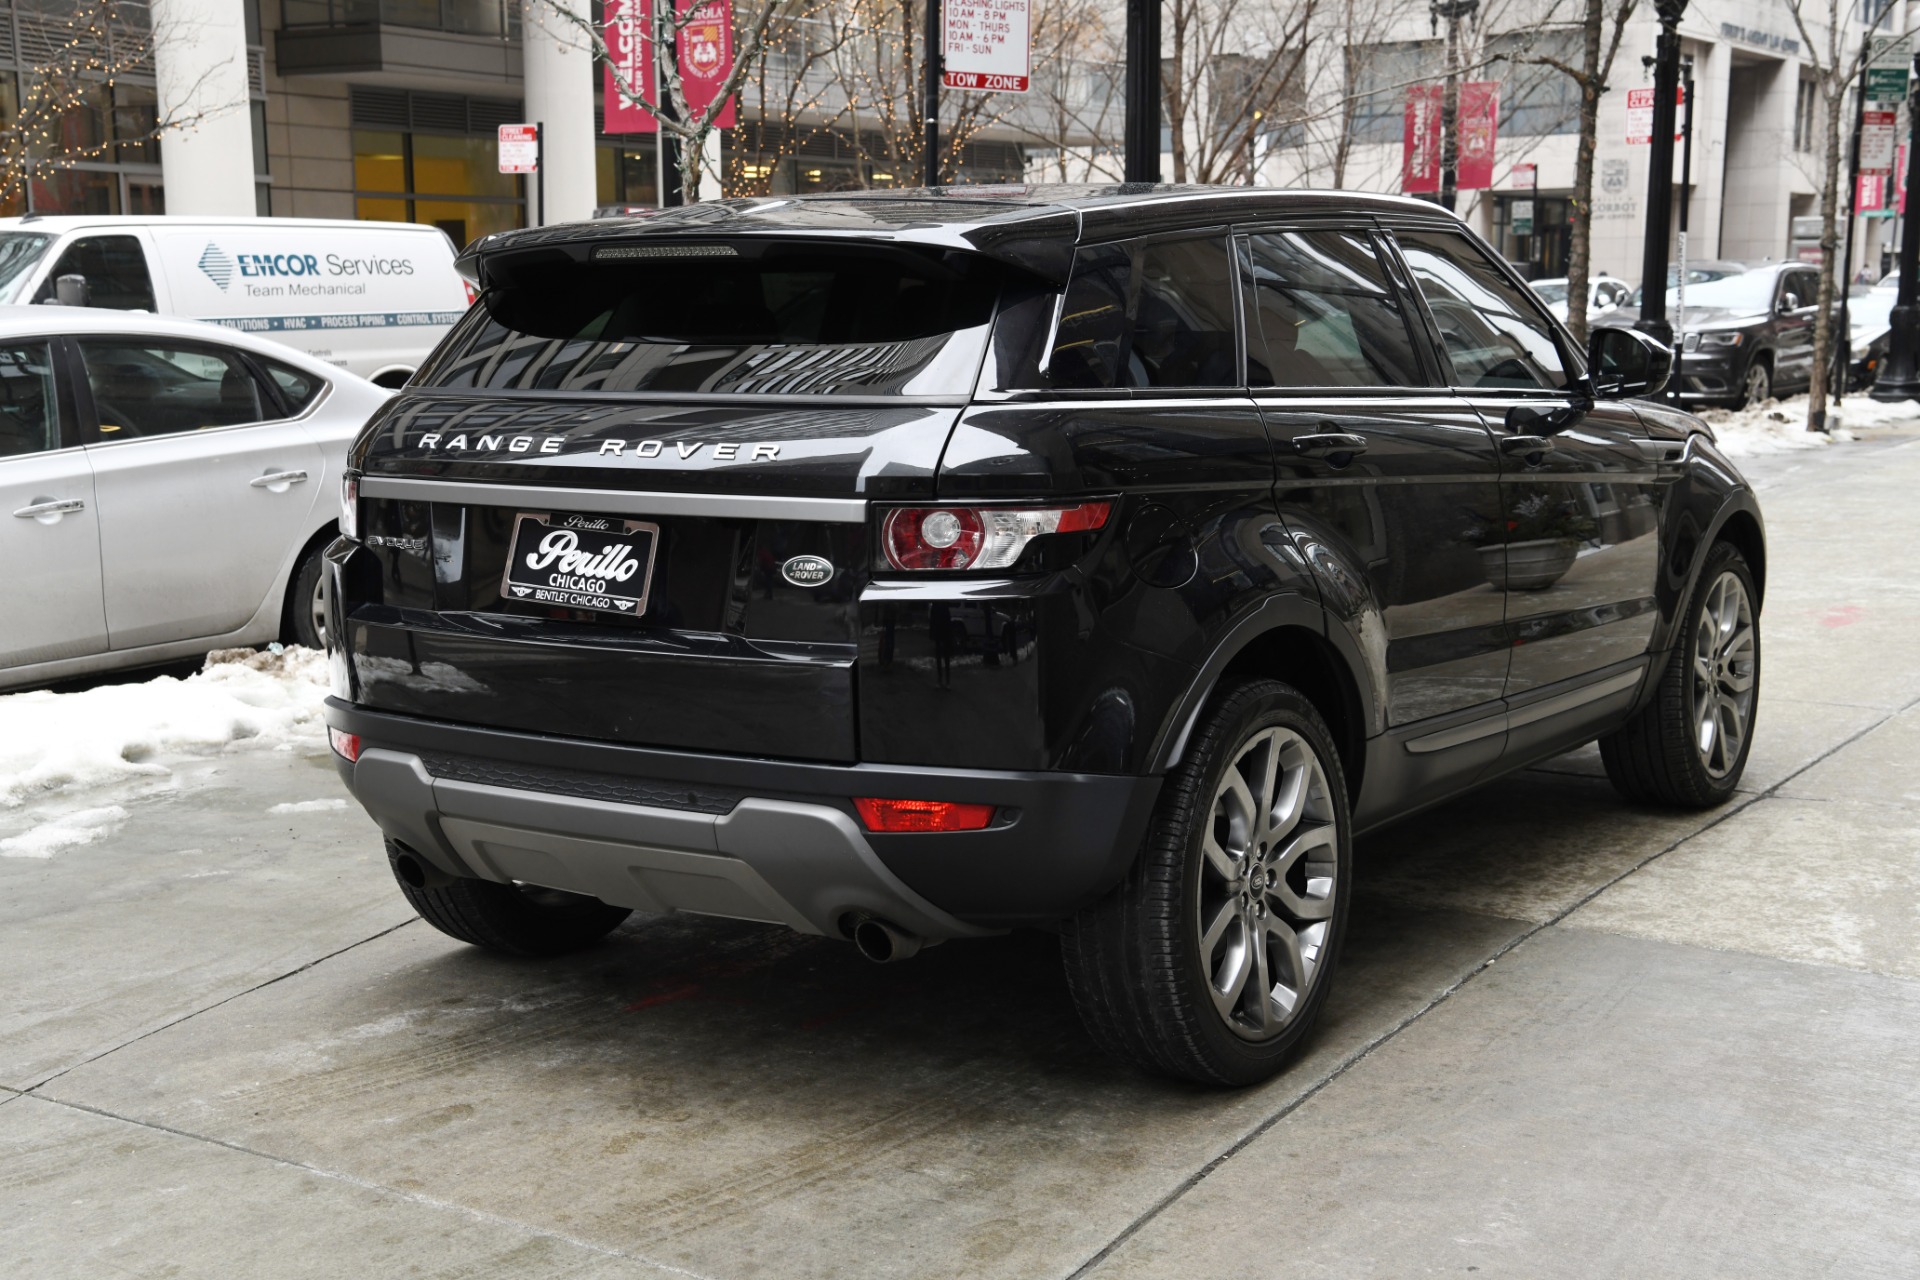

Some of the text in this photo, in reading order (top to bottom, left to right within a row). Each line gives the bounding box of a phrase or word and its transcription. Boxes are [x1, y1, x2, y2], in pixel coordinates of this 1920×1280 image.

[948, 0, 1025, 12] FLASHING LIGHTS
[949, 8, 958, 17] 10
[960, 9, 975, 18] AM
[984, 10, 990, 20] 8
[993, 11, 1006, 21] PM
[949, 19, 969, 29] MON
[980, 21, 1010, 33] THURS
[949, 31, 957, 40] 10
[959, 32, 973, 41] AM
[983, 34, 989, 43] 6
[991, 34, 1005, 44] PM
[948, 42, 964, 52] FRI
[972, 44, 992, 55] SUN
[948, 72, 1022, 90] TOW ZONE
[237, 253, 414, 276] EMCOR Services
[244, 282, 366, 297] Team Mechanical
[283, 317, 306, 329] HVAC
[321, 315, 358, 327] PROCESS
[359, 314, 386, 326] PIPING
[396, 313, 431, 325] CONTROL
[431, 312, 464, 325] SYSTEM
[417, 432, 781, 462] RANGE ROVER
[553, 514, 610, 530] Perillo
[367, 535, 426, 550] EVOQUE
[526, 529, 639, 582] Perillo
[792, 562, 817, 571] LAND
[794, 570, 824, 580] ROVER
[549, 573, 606, 593] CHICAGO
[535, 589, 610, 609] BENTLEY CHICAGO
